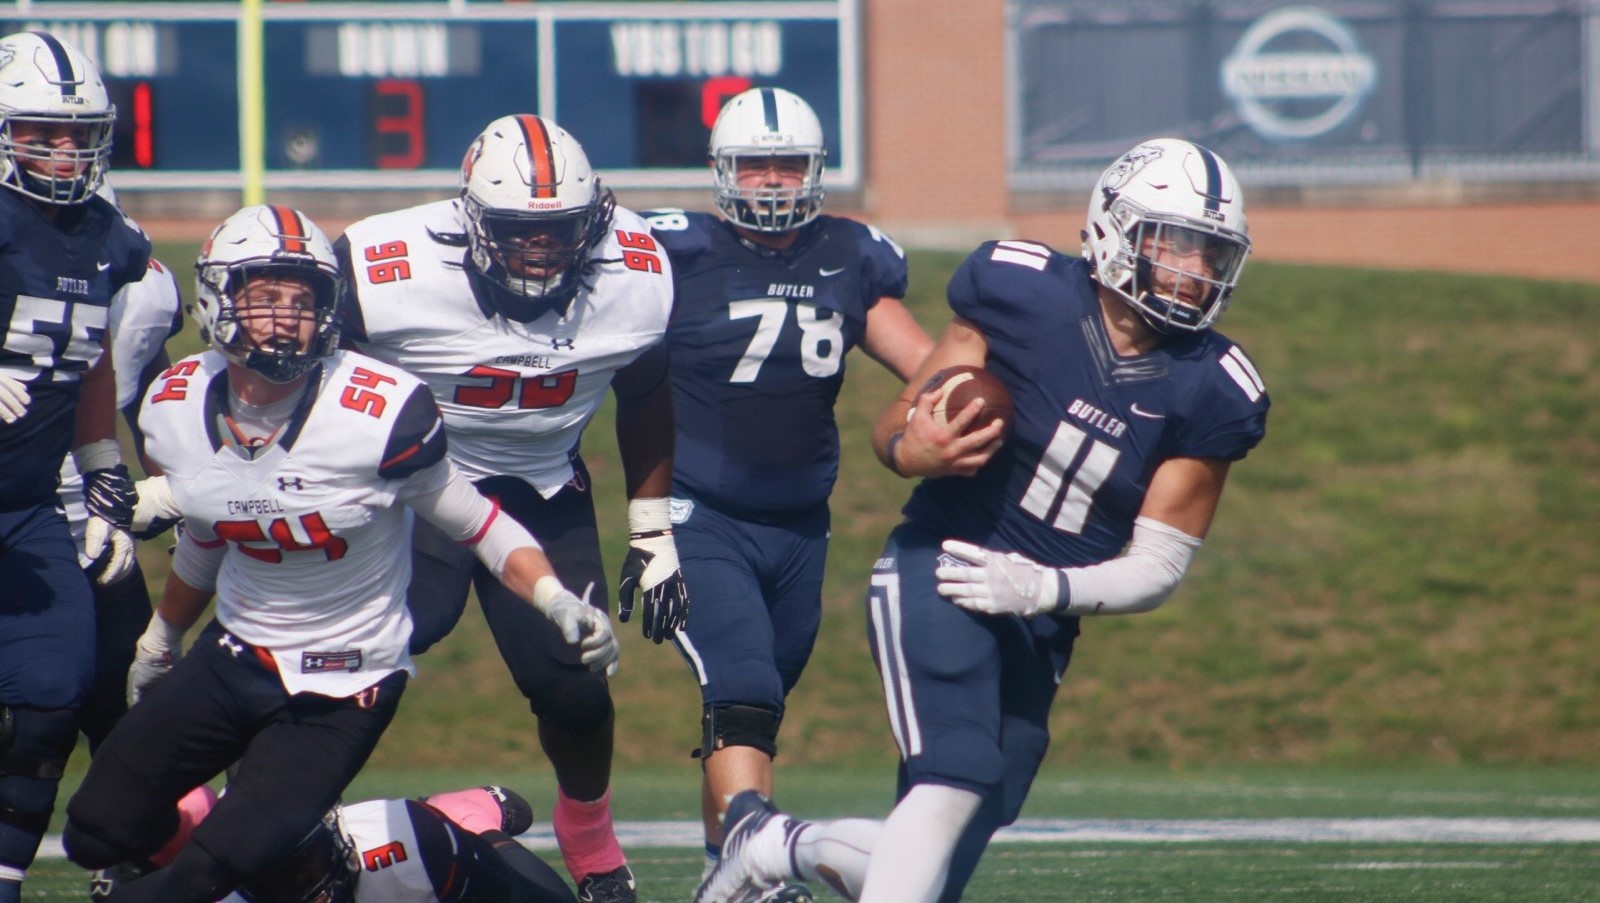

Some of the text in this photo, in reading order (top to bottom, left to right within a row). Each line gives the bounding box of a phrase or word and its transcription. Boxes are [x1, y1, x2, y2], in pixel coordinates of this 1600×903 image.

[133, 82, 153, 169] 1
[374, 78, 425, 170] 3
[528, 200, 562, 209] Riddell
[56, 276, 89, 295] BUTLER
[767, 283, 815, 299] BUTLER
[728, 297, 845, 384] 78
[494, 355, 552, 369] CAMPBELL
[1067, 399, 1127, 438] BUTLER
[1019, 420, 1122, 535] 11
[227, 499, 285, 516] CAMPBELL
